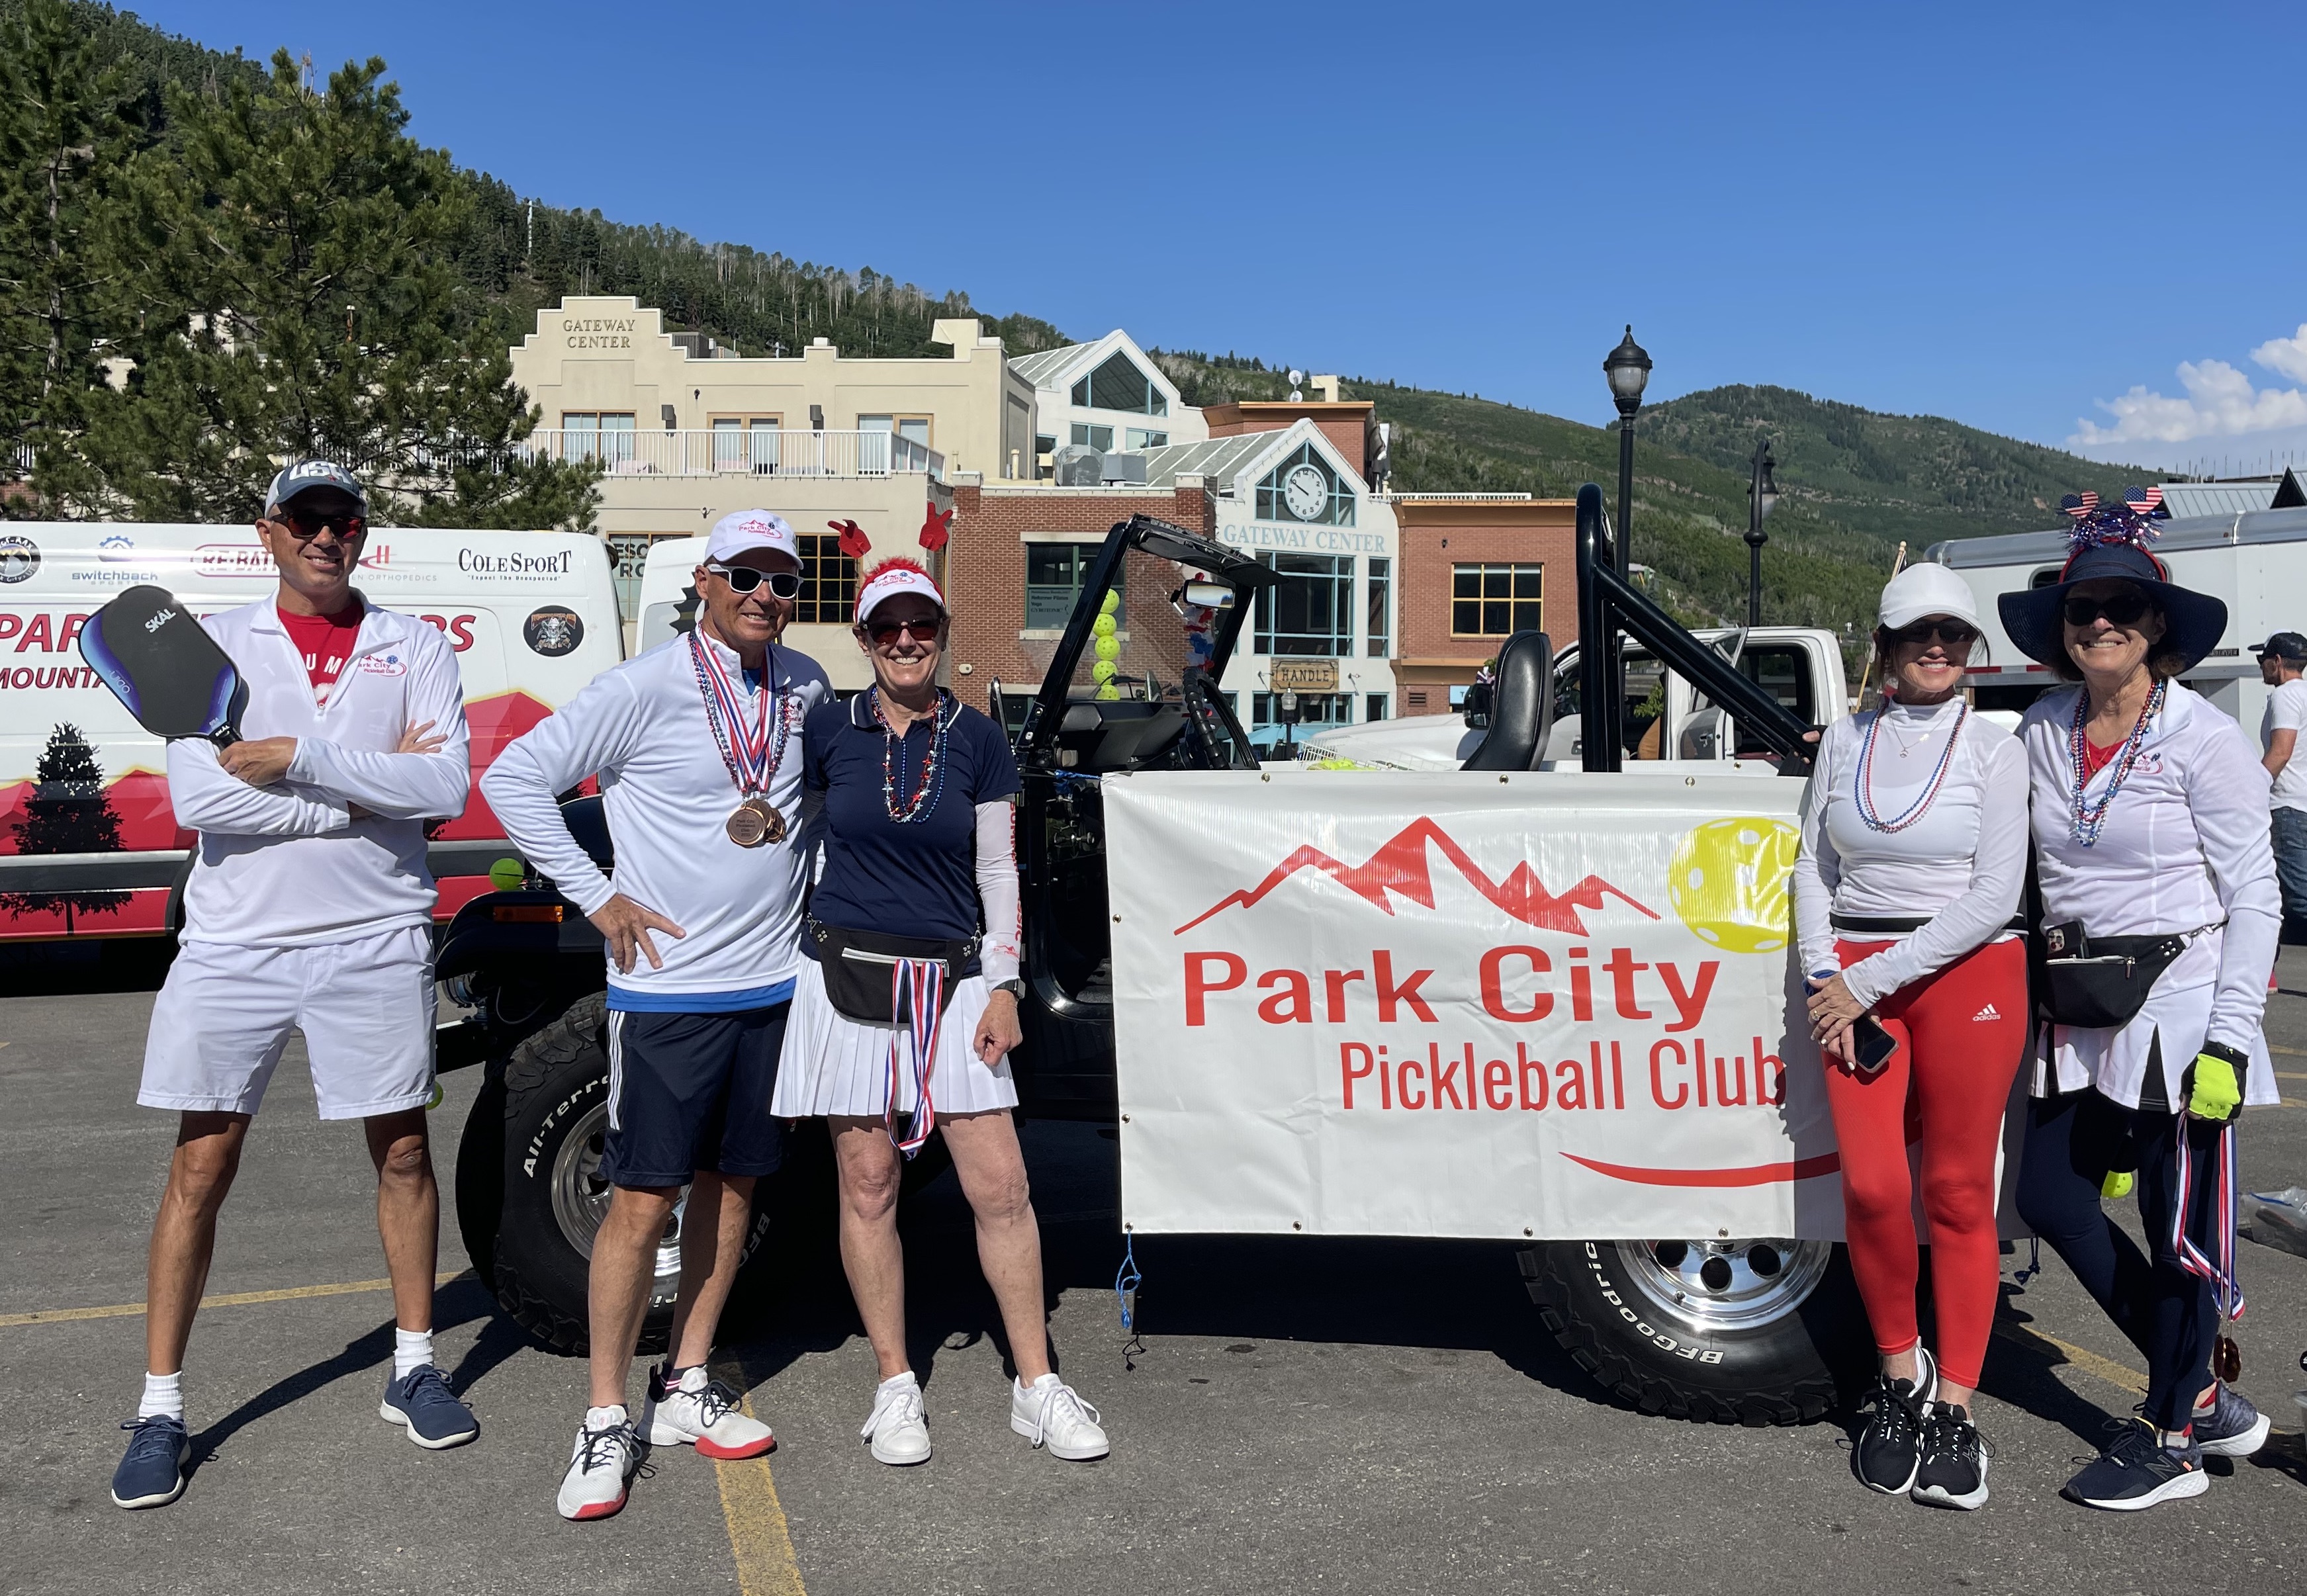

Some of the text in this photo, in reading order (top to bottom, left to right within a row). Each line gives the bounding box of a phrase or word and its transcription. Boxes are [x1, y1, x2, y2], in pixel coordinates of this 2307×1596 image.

[563, 319, 636, 332] GATEWAY
[566, 335, 631, 348] CENTER
[289, 460, 353, 486] USA
[1224, 523, 1386, 553] GATEWAY CENTER
[613, 543, 649, 559] ESC
[71, 570, 158, 581] switchback
[619, 562, 645, 578] RO
[1281, 669, 1330, 682] HANDLE
[1184, 945, 1721, 1033] Park City
[1339, 1036, 1786, 1111] Pickleball Club
[1585, 1241, 1725, 1365] BFGoodric
